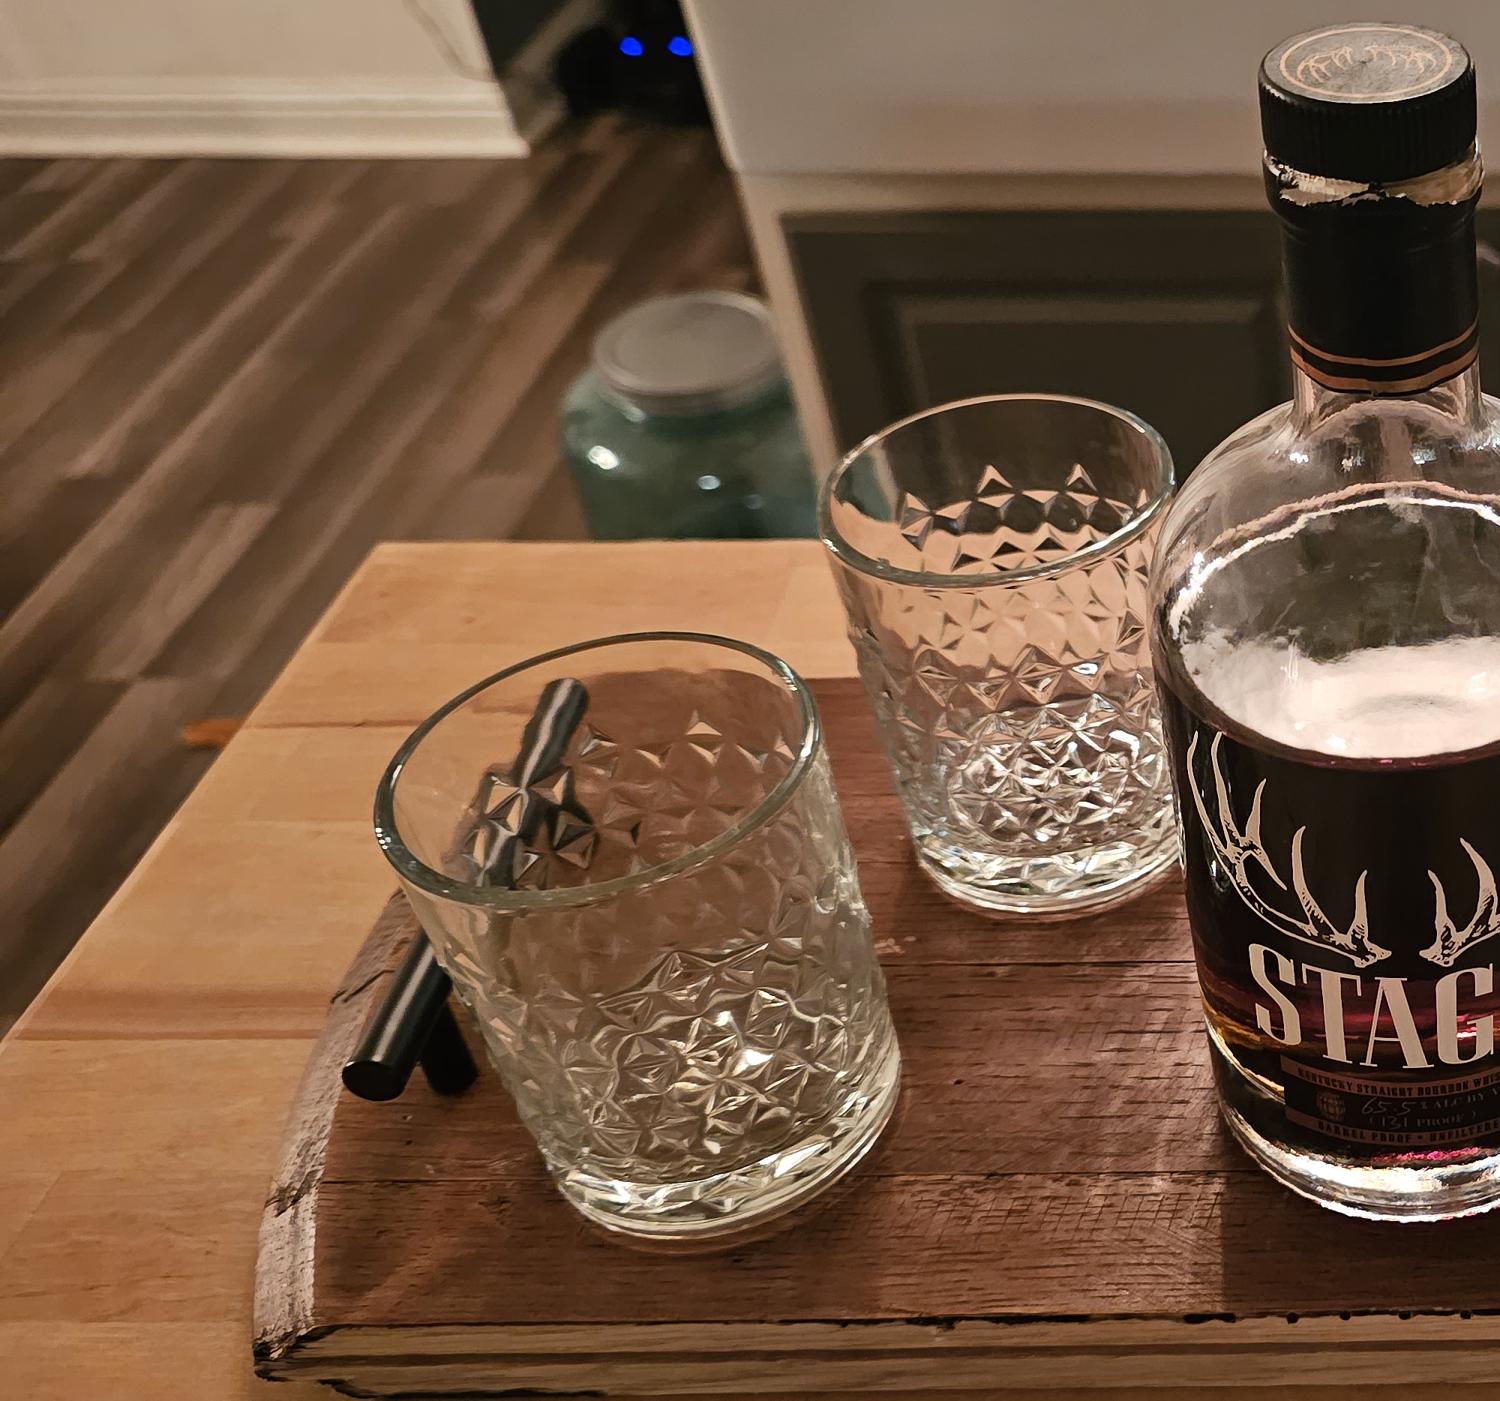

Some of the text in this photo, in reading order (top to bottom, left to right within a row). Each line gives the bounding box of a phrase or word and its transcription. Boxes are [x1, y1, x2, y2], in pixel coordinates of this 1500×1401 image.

[1356, 1083, 1412, 1097] STRAIGHT
[1417, 1080, 1468, 1096] BOURBON
[1319, 1121, 1364, 1139] BARREL
[1371, 1132, 1410, 1143] PROOF
